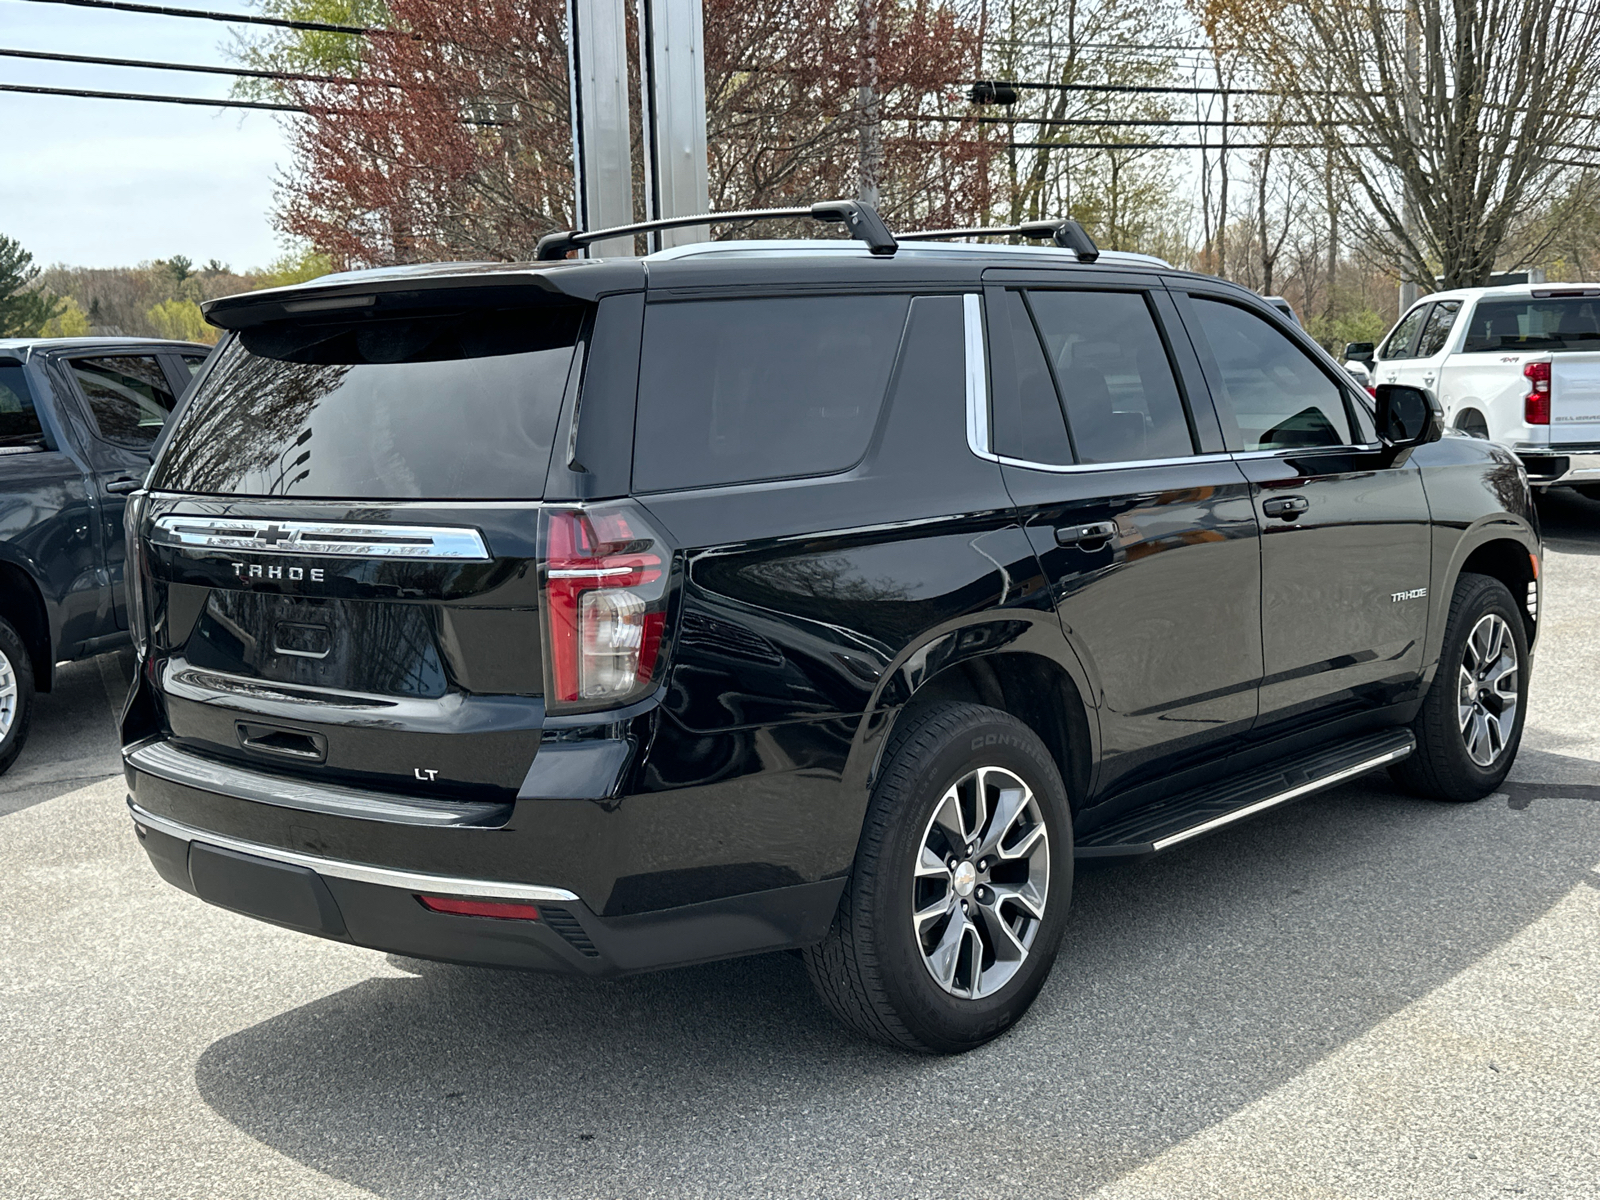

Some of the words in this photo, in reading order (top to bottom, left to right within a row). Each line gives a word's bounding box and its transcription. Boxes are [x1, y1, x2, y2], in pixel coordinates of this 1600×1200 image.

[231, 562, 324, 582] TAHOE
[1391, 587, 1427, 602] TAHOE
[414, 768, 439, 781] LT
